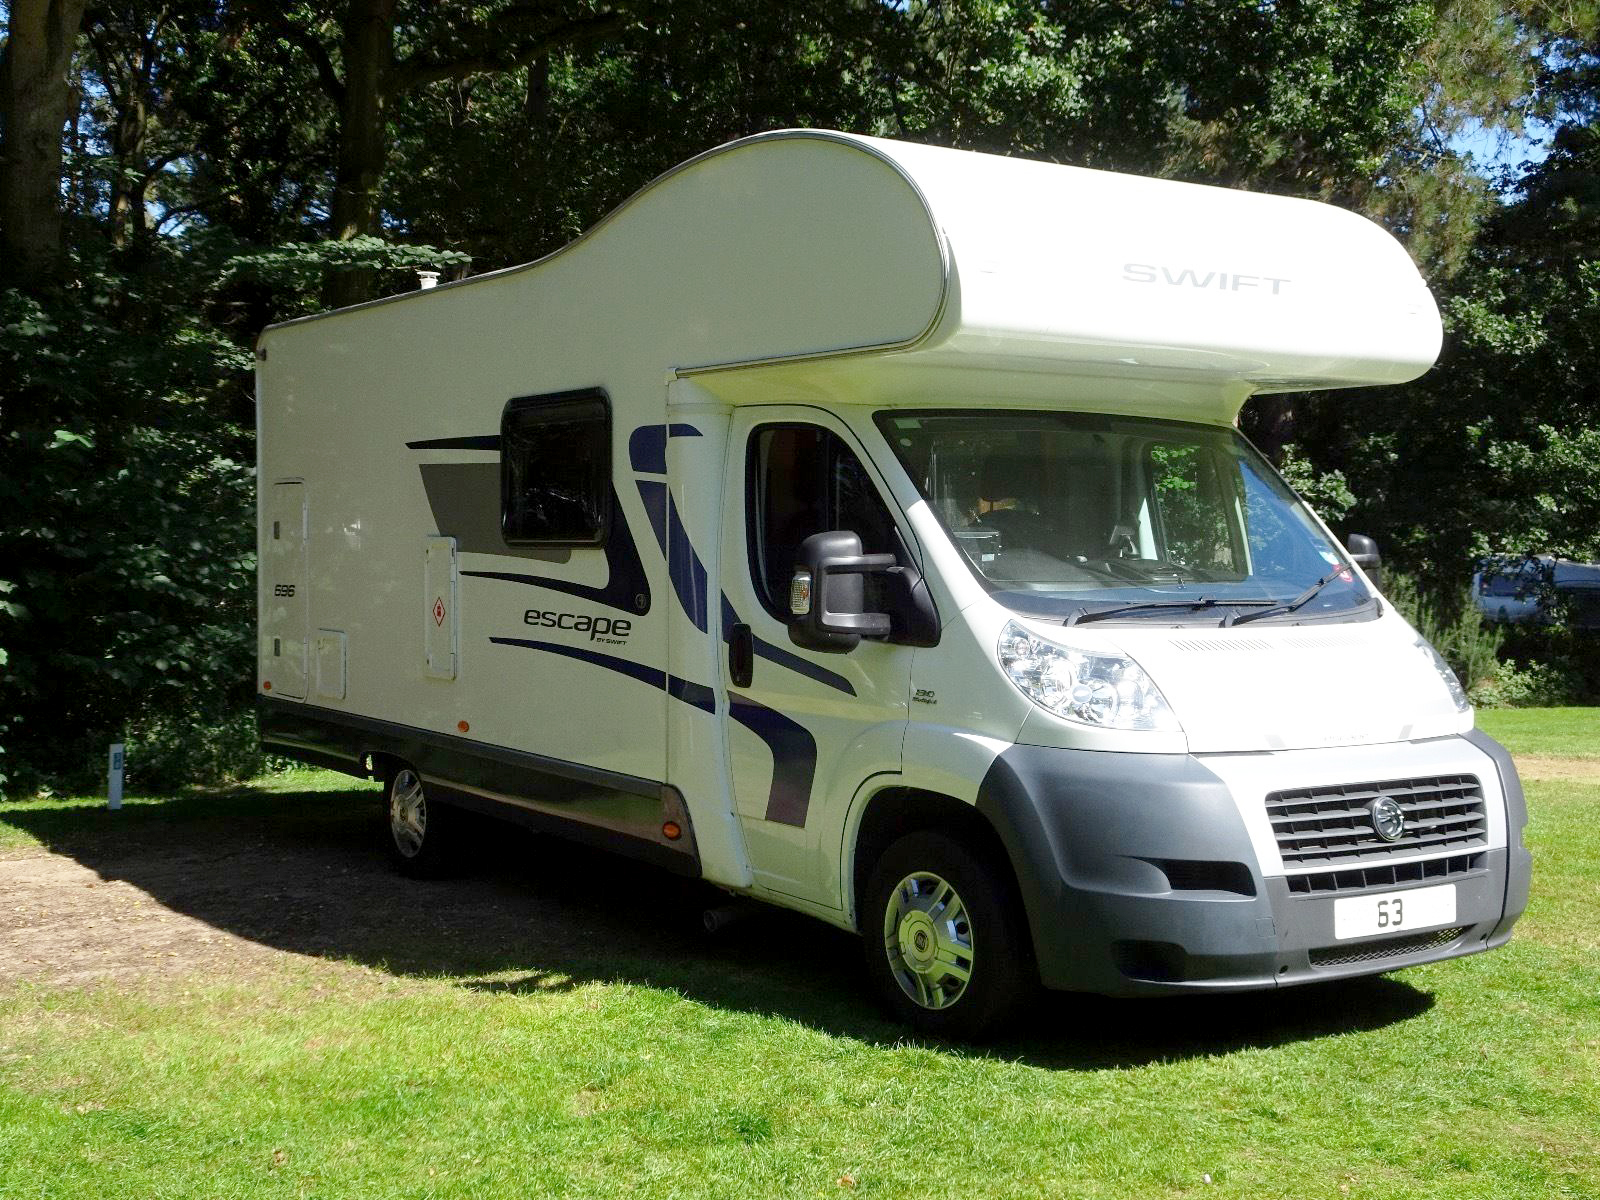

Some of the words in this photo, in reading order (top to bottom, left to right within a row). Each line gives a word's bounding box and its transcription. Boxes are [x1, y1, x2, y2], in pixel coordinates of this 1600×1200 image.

[1123, 263, 1292, 295] SWIFT
[524, 609, 631, 641] escape
[1378, 899, 1403, 928] 63
